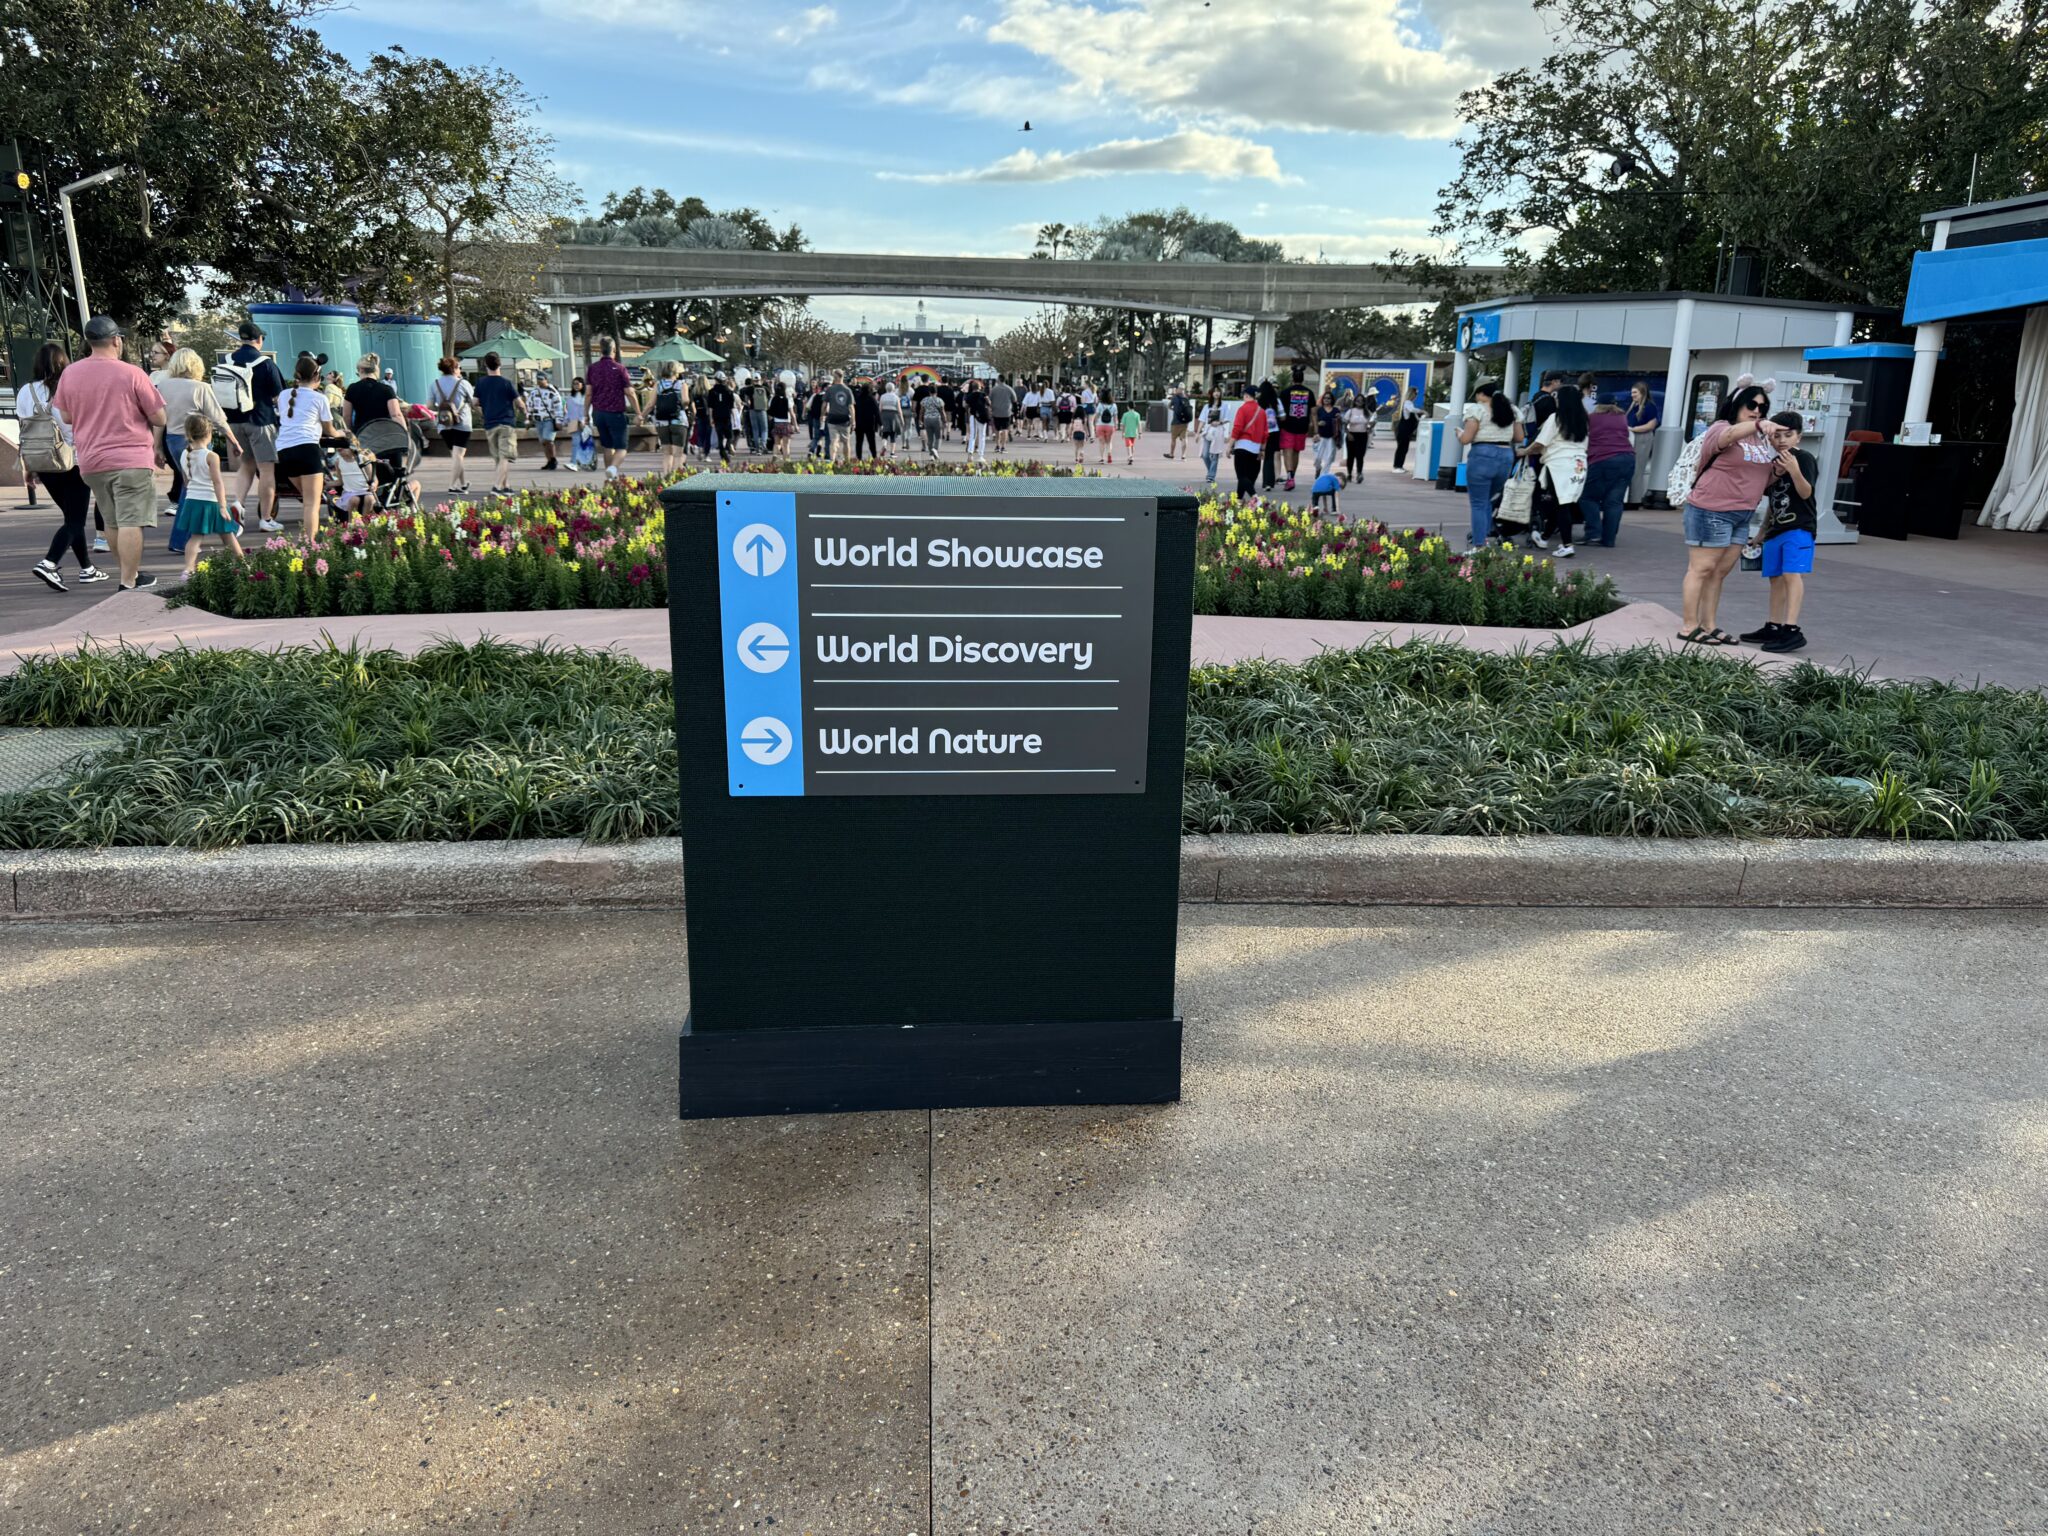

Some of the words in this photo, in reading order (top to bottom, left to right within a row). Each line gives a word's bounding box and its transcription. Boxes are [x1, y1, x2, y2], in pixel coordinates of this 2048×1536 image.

[814, 537, 918, 567] World
[928, 538, 1103, 568] Showcase
[816, 634, 919, 663] World
[928, 635, 1093, 671] Discovery
[819, 727, 919, 755] World
[928, 728, 1043, 755] Nature
